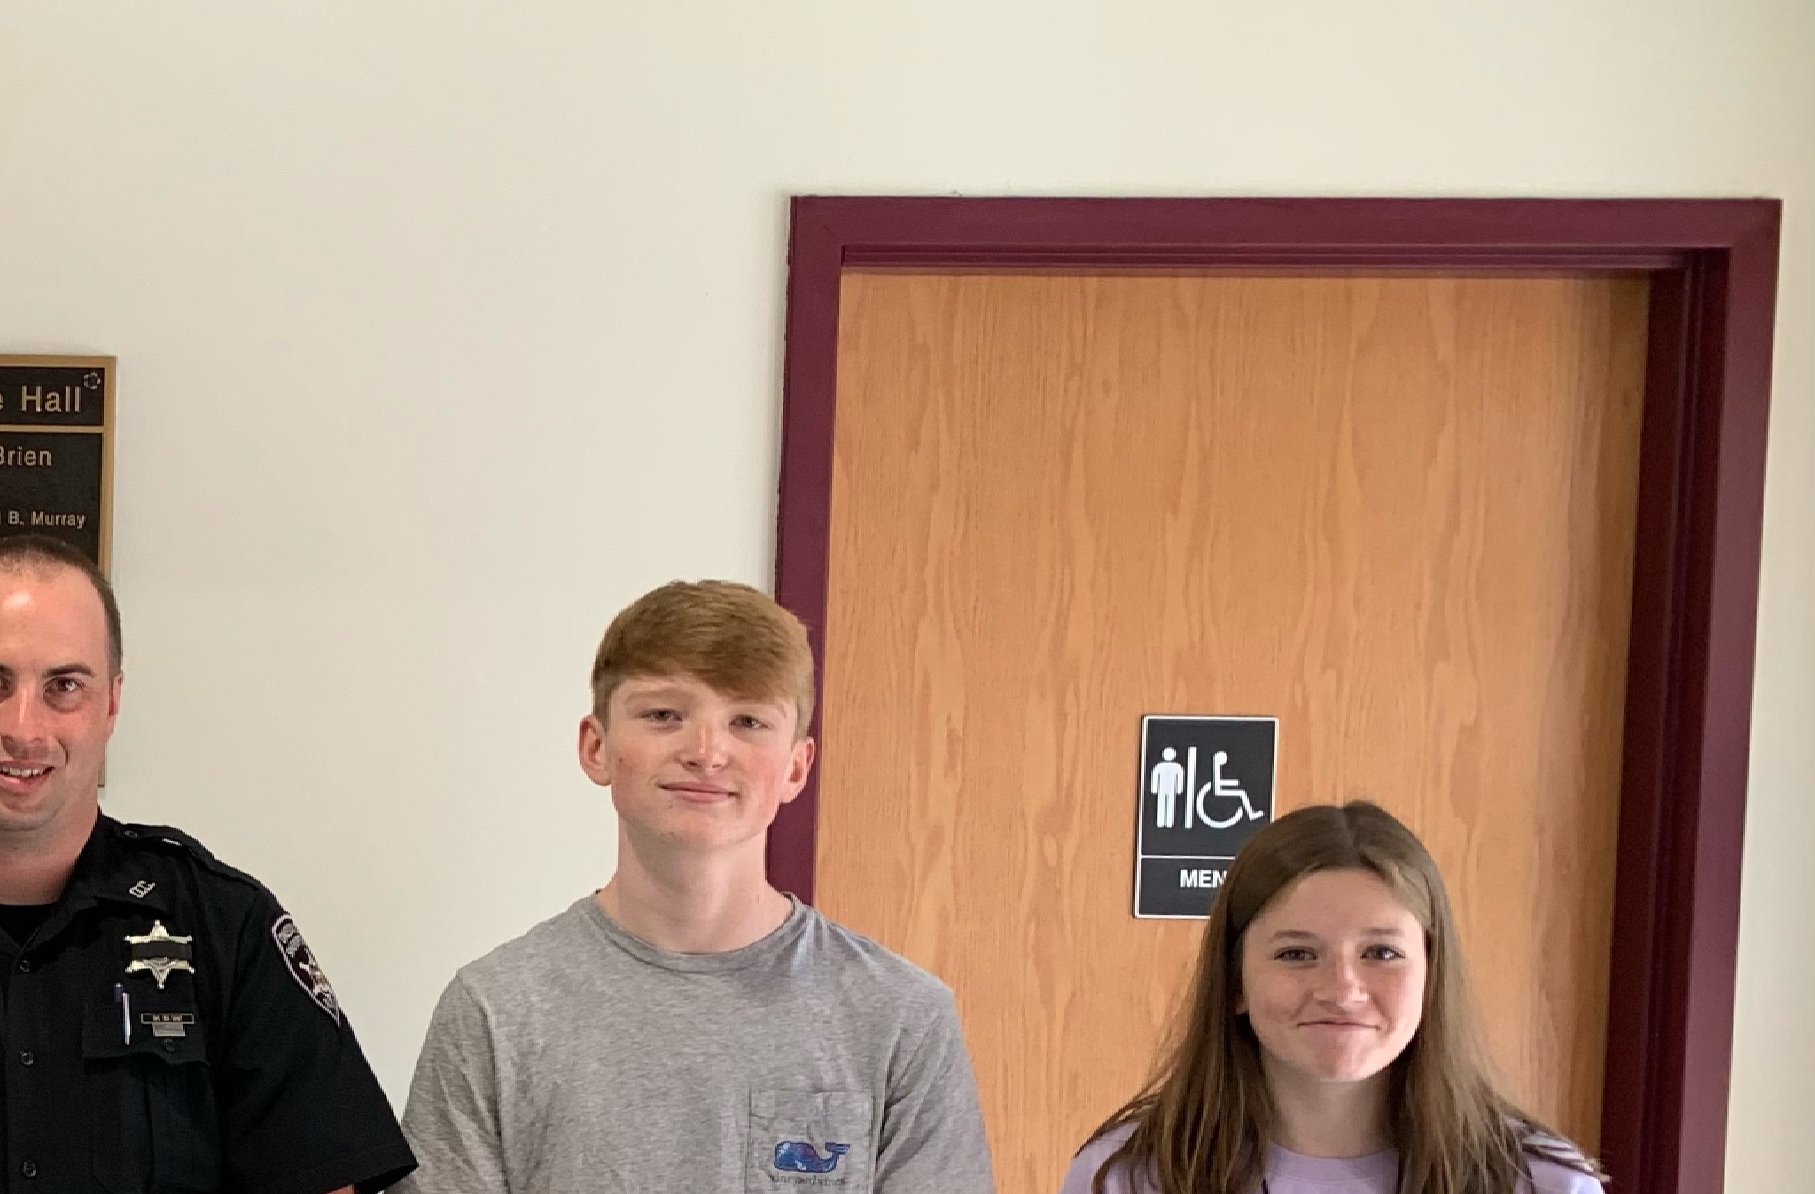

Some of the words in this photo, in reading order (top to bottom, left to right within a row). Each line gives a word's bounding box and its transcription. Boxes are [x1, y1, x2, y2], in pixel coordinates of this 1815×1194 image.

[19, 384, 83, 413] Hall
[7, 510, 24, 526] B.
[30, 511, 87, 530] Murray
[1179, 869, 1228, 888] MEN
